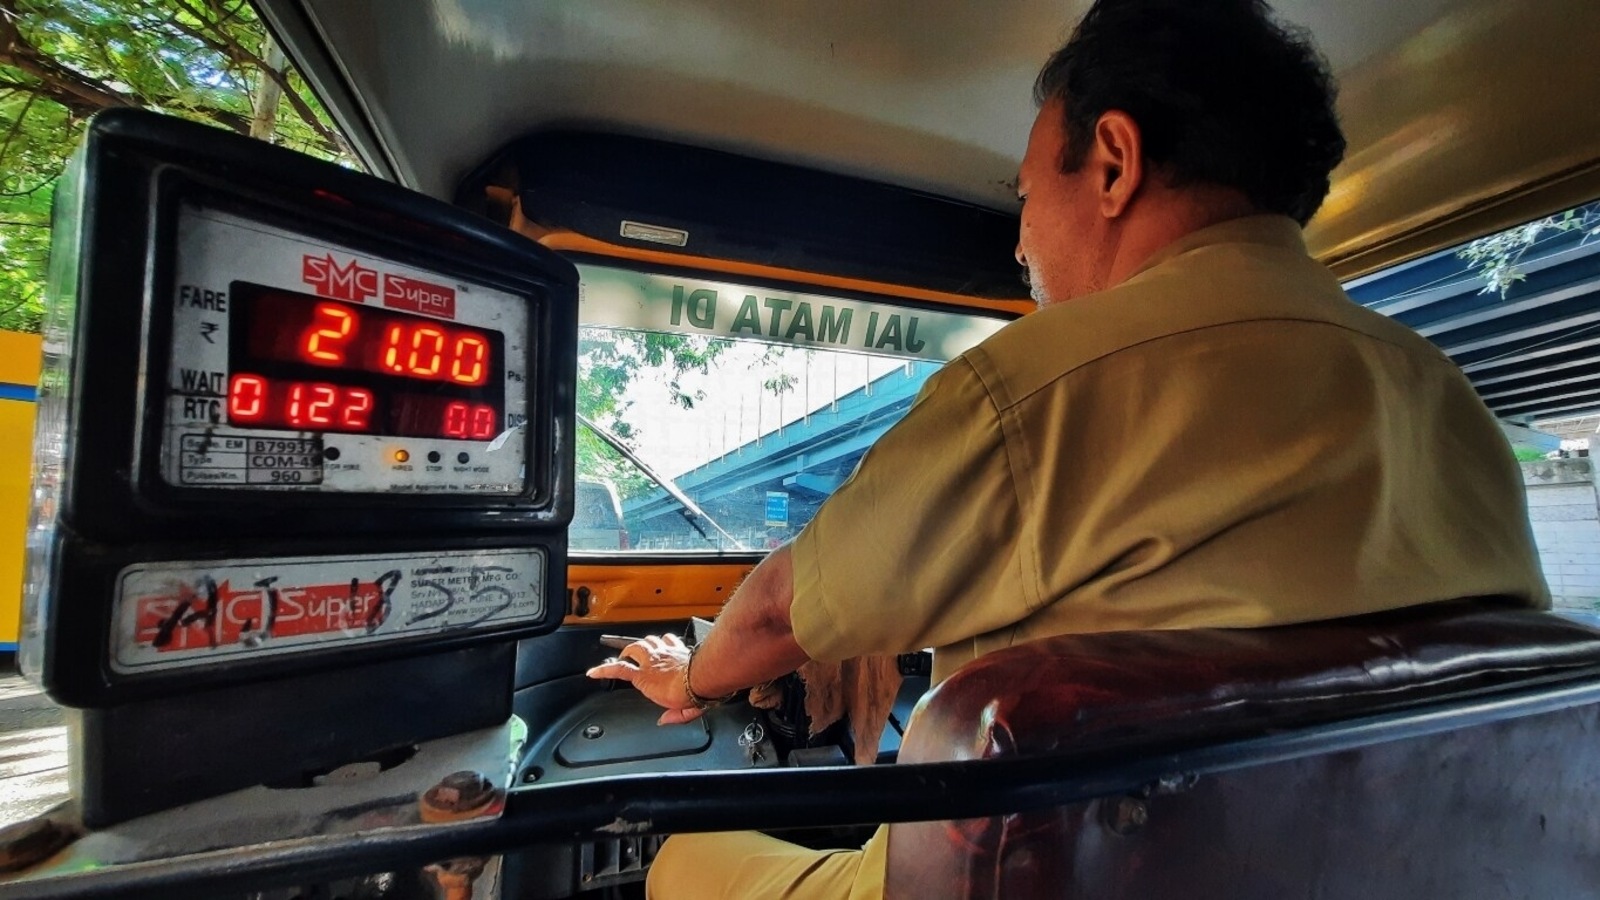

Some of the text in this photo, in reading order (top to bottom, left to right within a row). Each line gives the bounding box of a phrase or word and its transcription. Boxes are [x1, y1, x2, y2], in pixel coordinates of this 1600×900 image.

[303, 254, 378, 302] SMC
[385, 277, 452, 313] Super
[180, 285, 226, 312] FARE
[181, 369, 225, 392] WAIT
[184, 398, 221, 422] RTC
[271, 470, 302, 482] 960
[274, 590, 378, 629] Super
